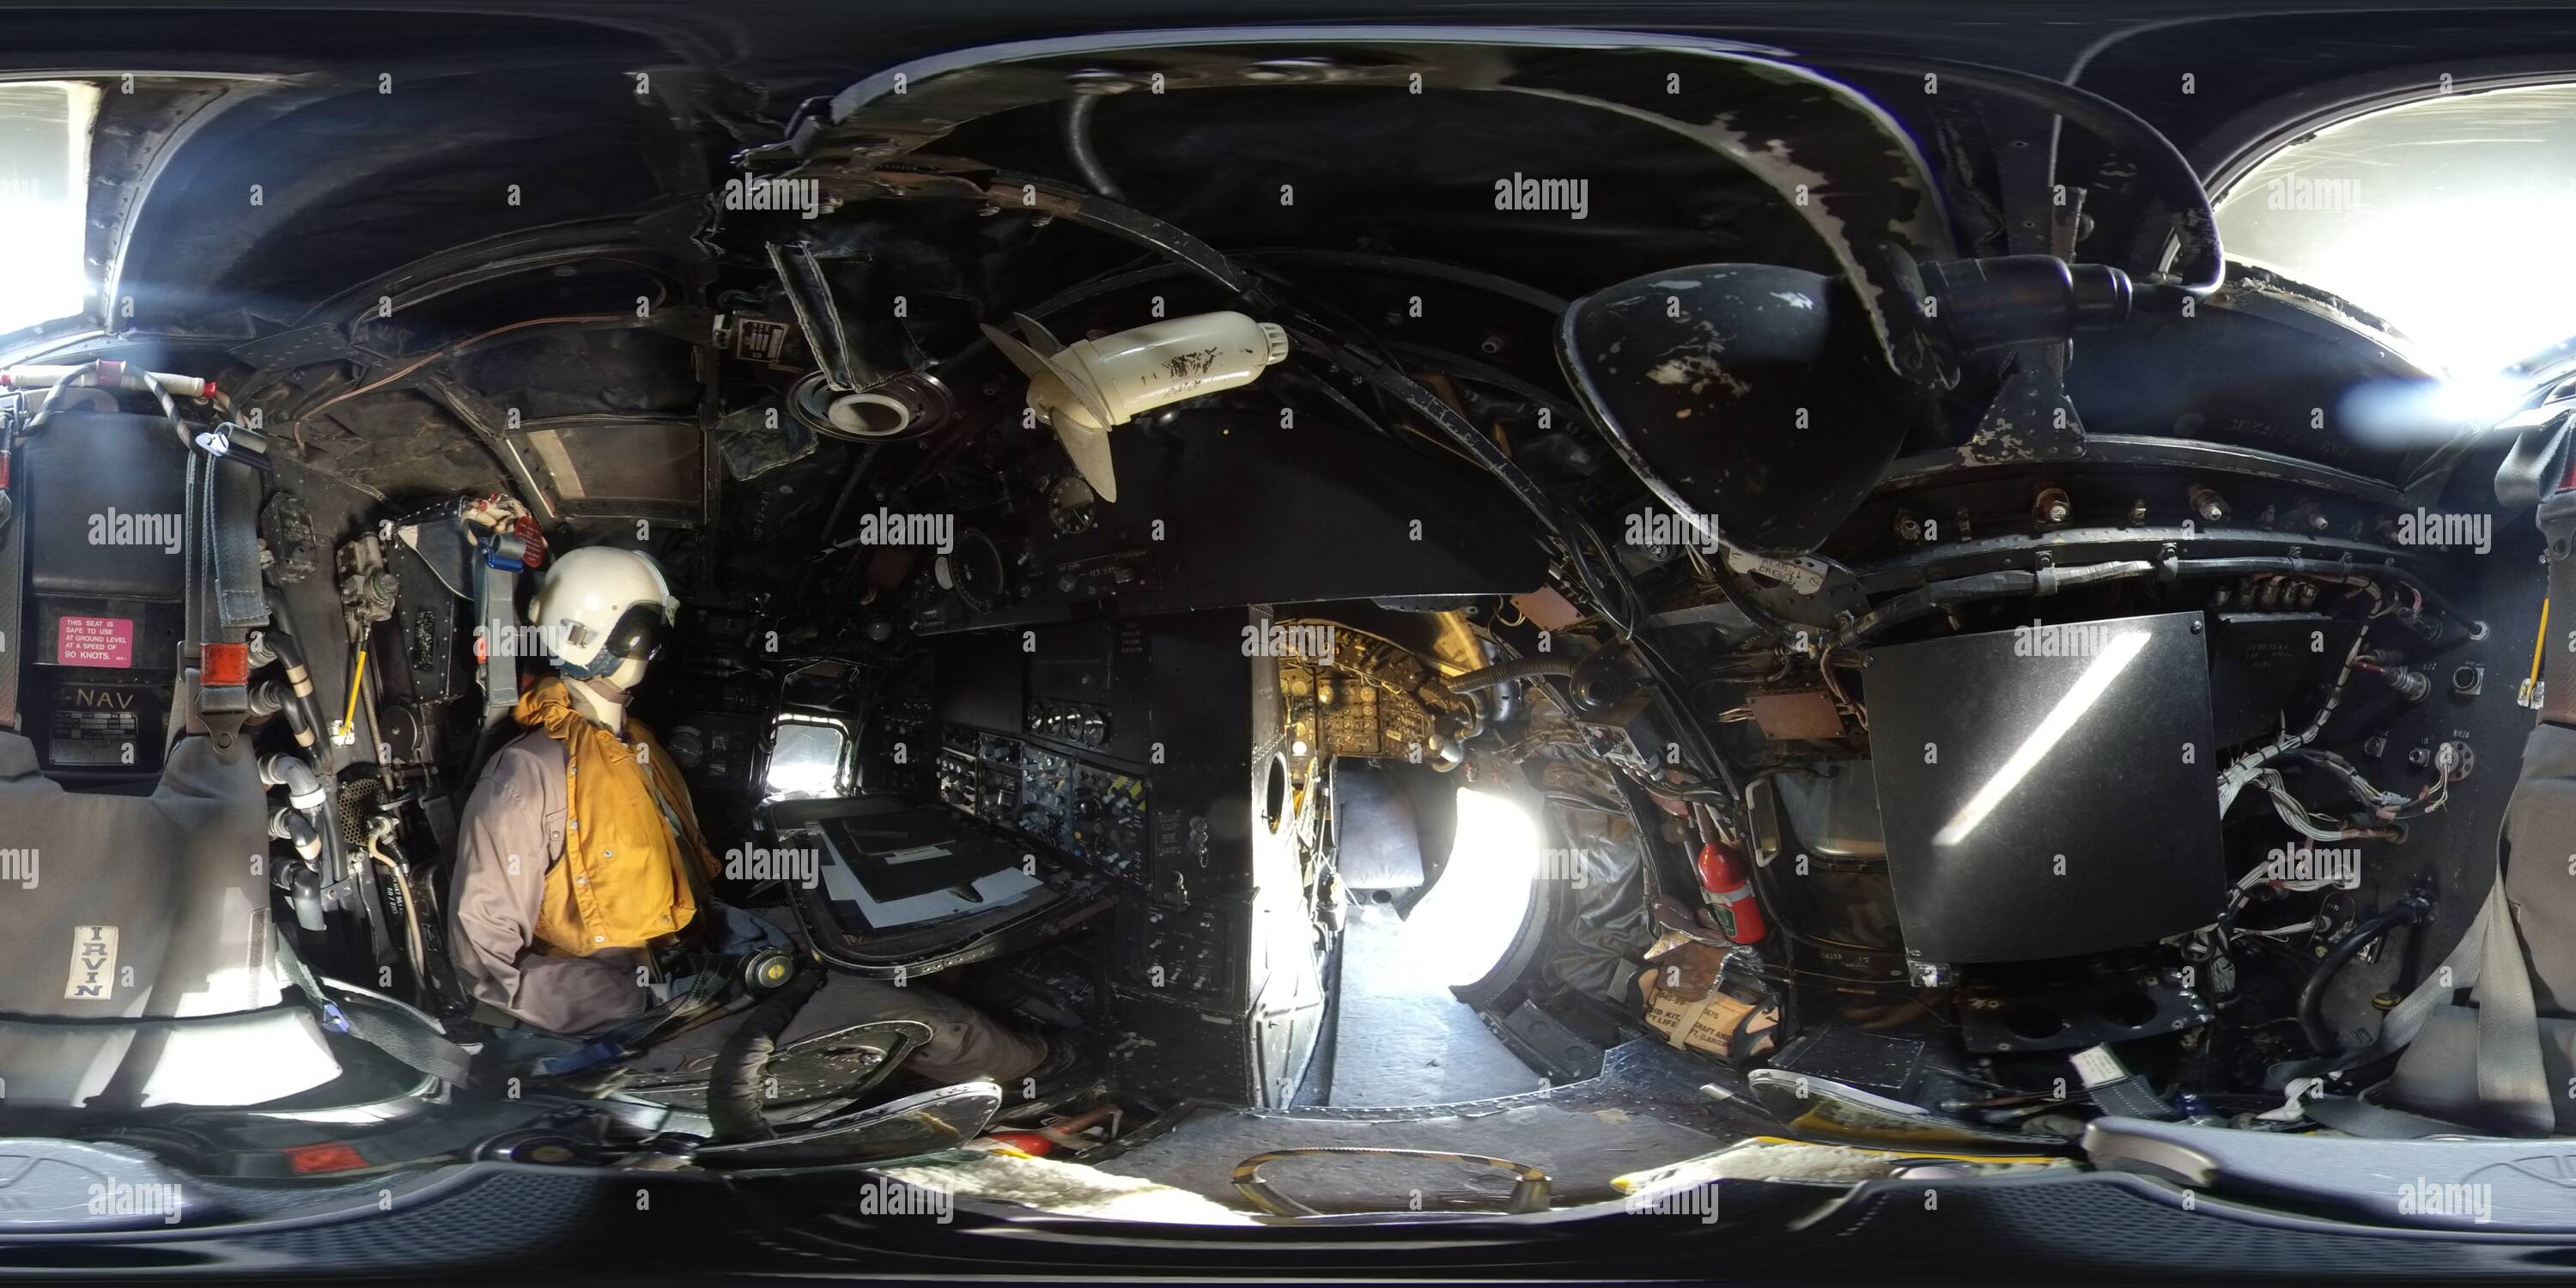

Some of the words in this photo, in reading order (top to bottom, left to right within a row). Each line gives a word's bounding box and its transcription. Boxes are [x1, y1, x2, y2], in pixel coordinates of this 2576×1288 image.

[64, 650, 76, 659] 90
[81, 651, 111, 660] KNOTS.
[75, 927, 107, 996] IRVIN
